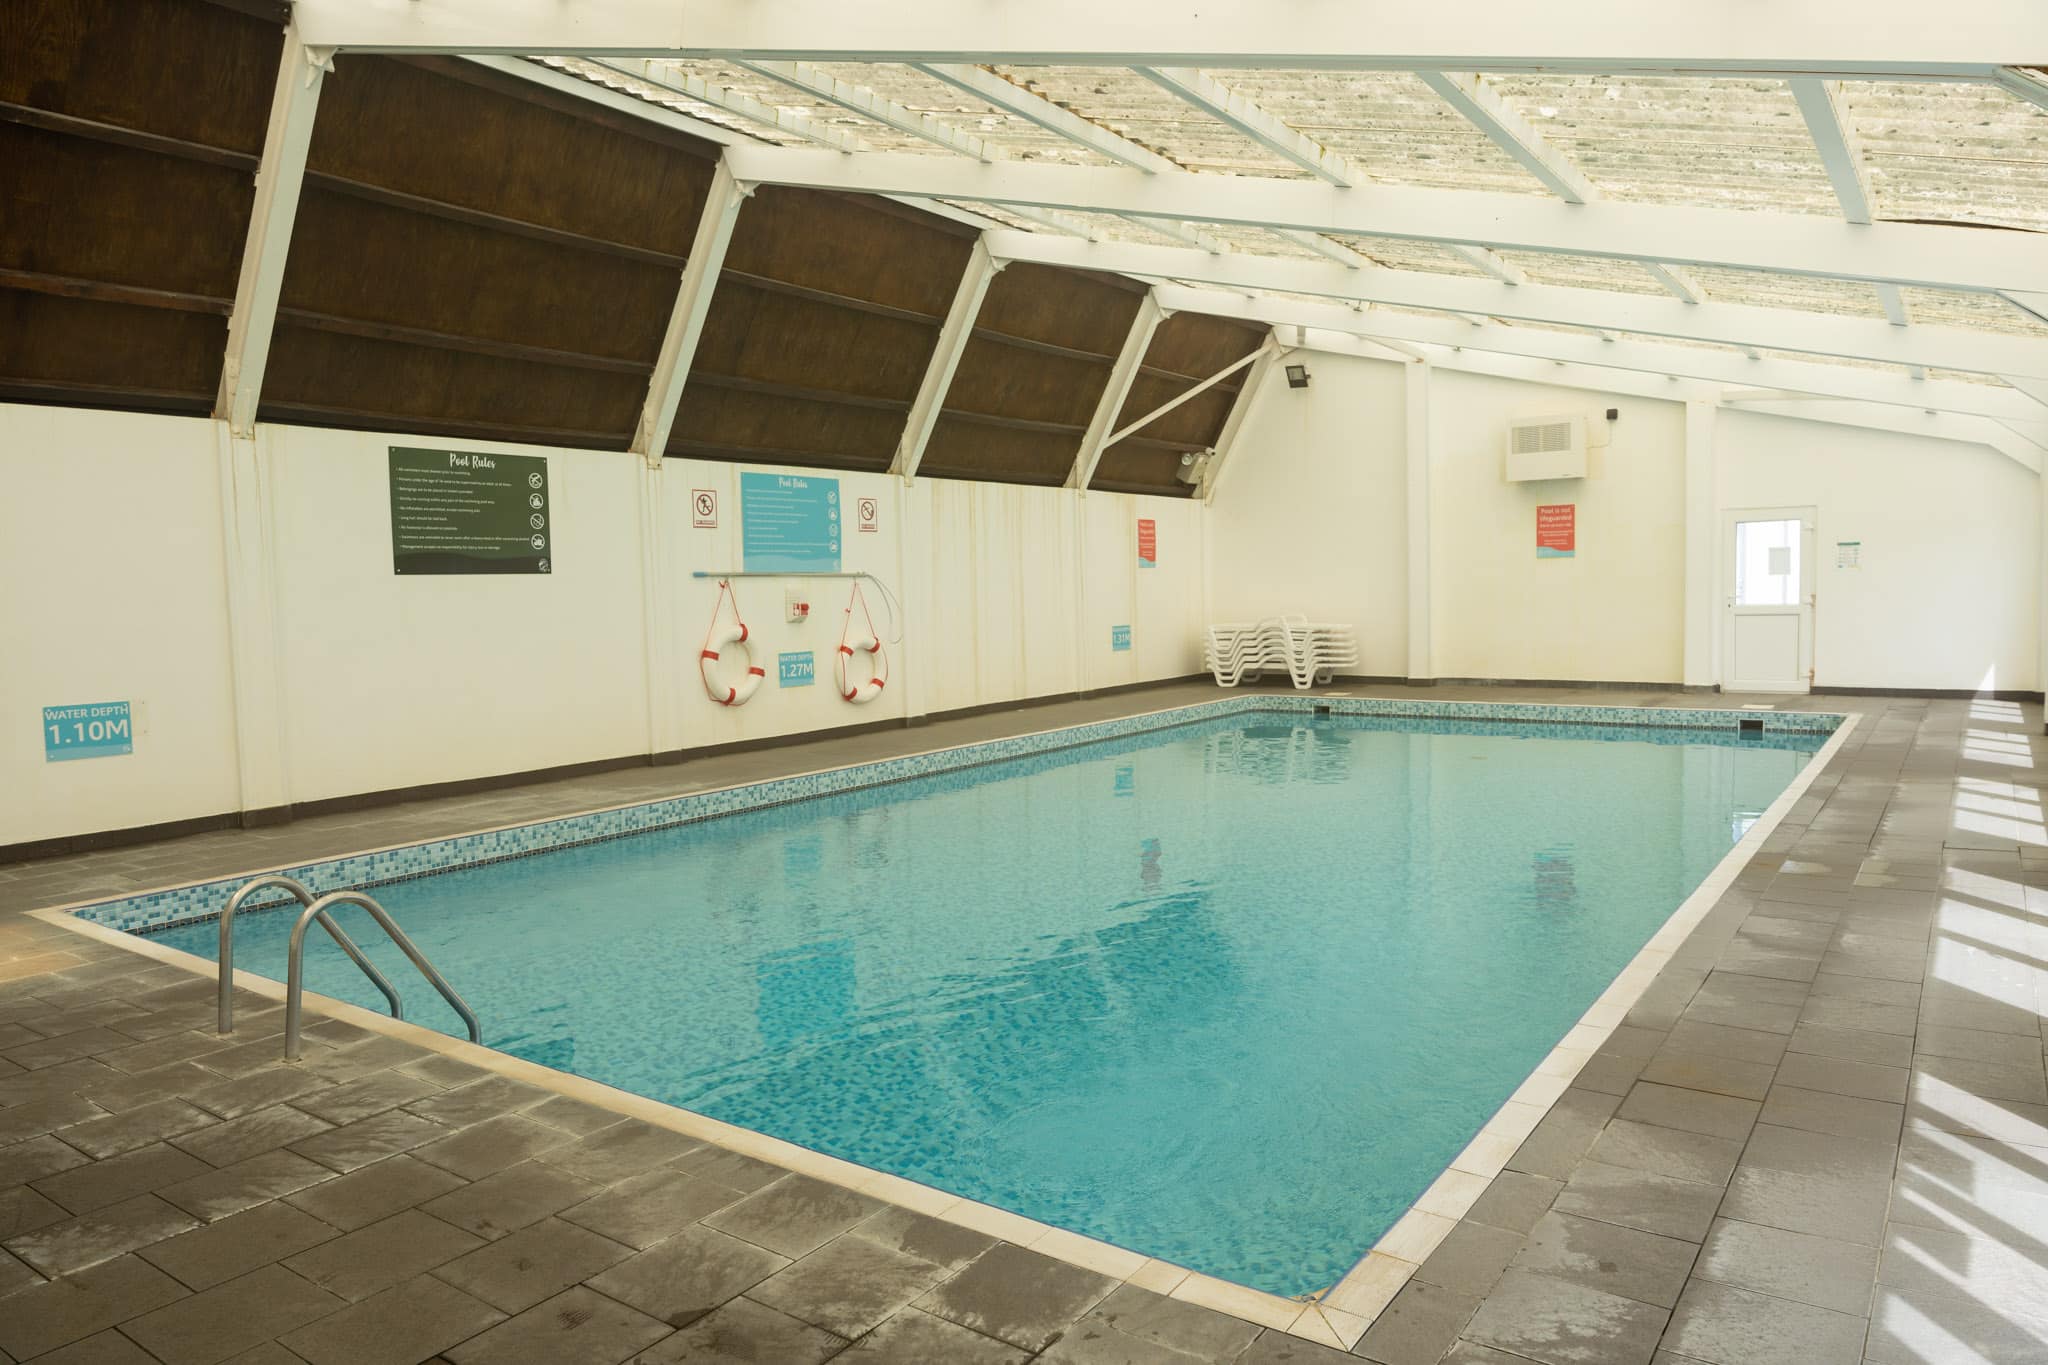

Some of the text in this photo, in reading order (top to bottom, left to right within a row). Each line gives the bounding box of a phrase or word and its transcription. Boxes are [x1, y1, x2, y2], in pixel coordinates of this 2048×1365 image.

[450, 452, 496, 469] Pool Rules
[780, 663, 813, 678] 1.27M
[45, 705, 128, 720] WATER DEPTH
[48, 719, 128, 745] 1.10M
